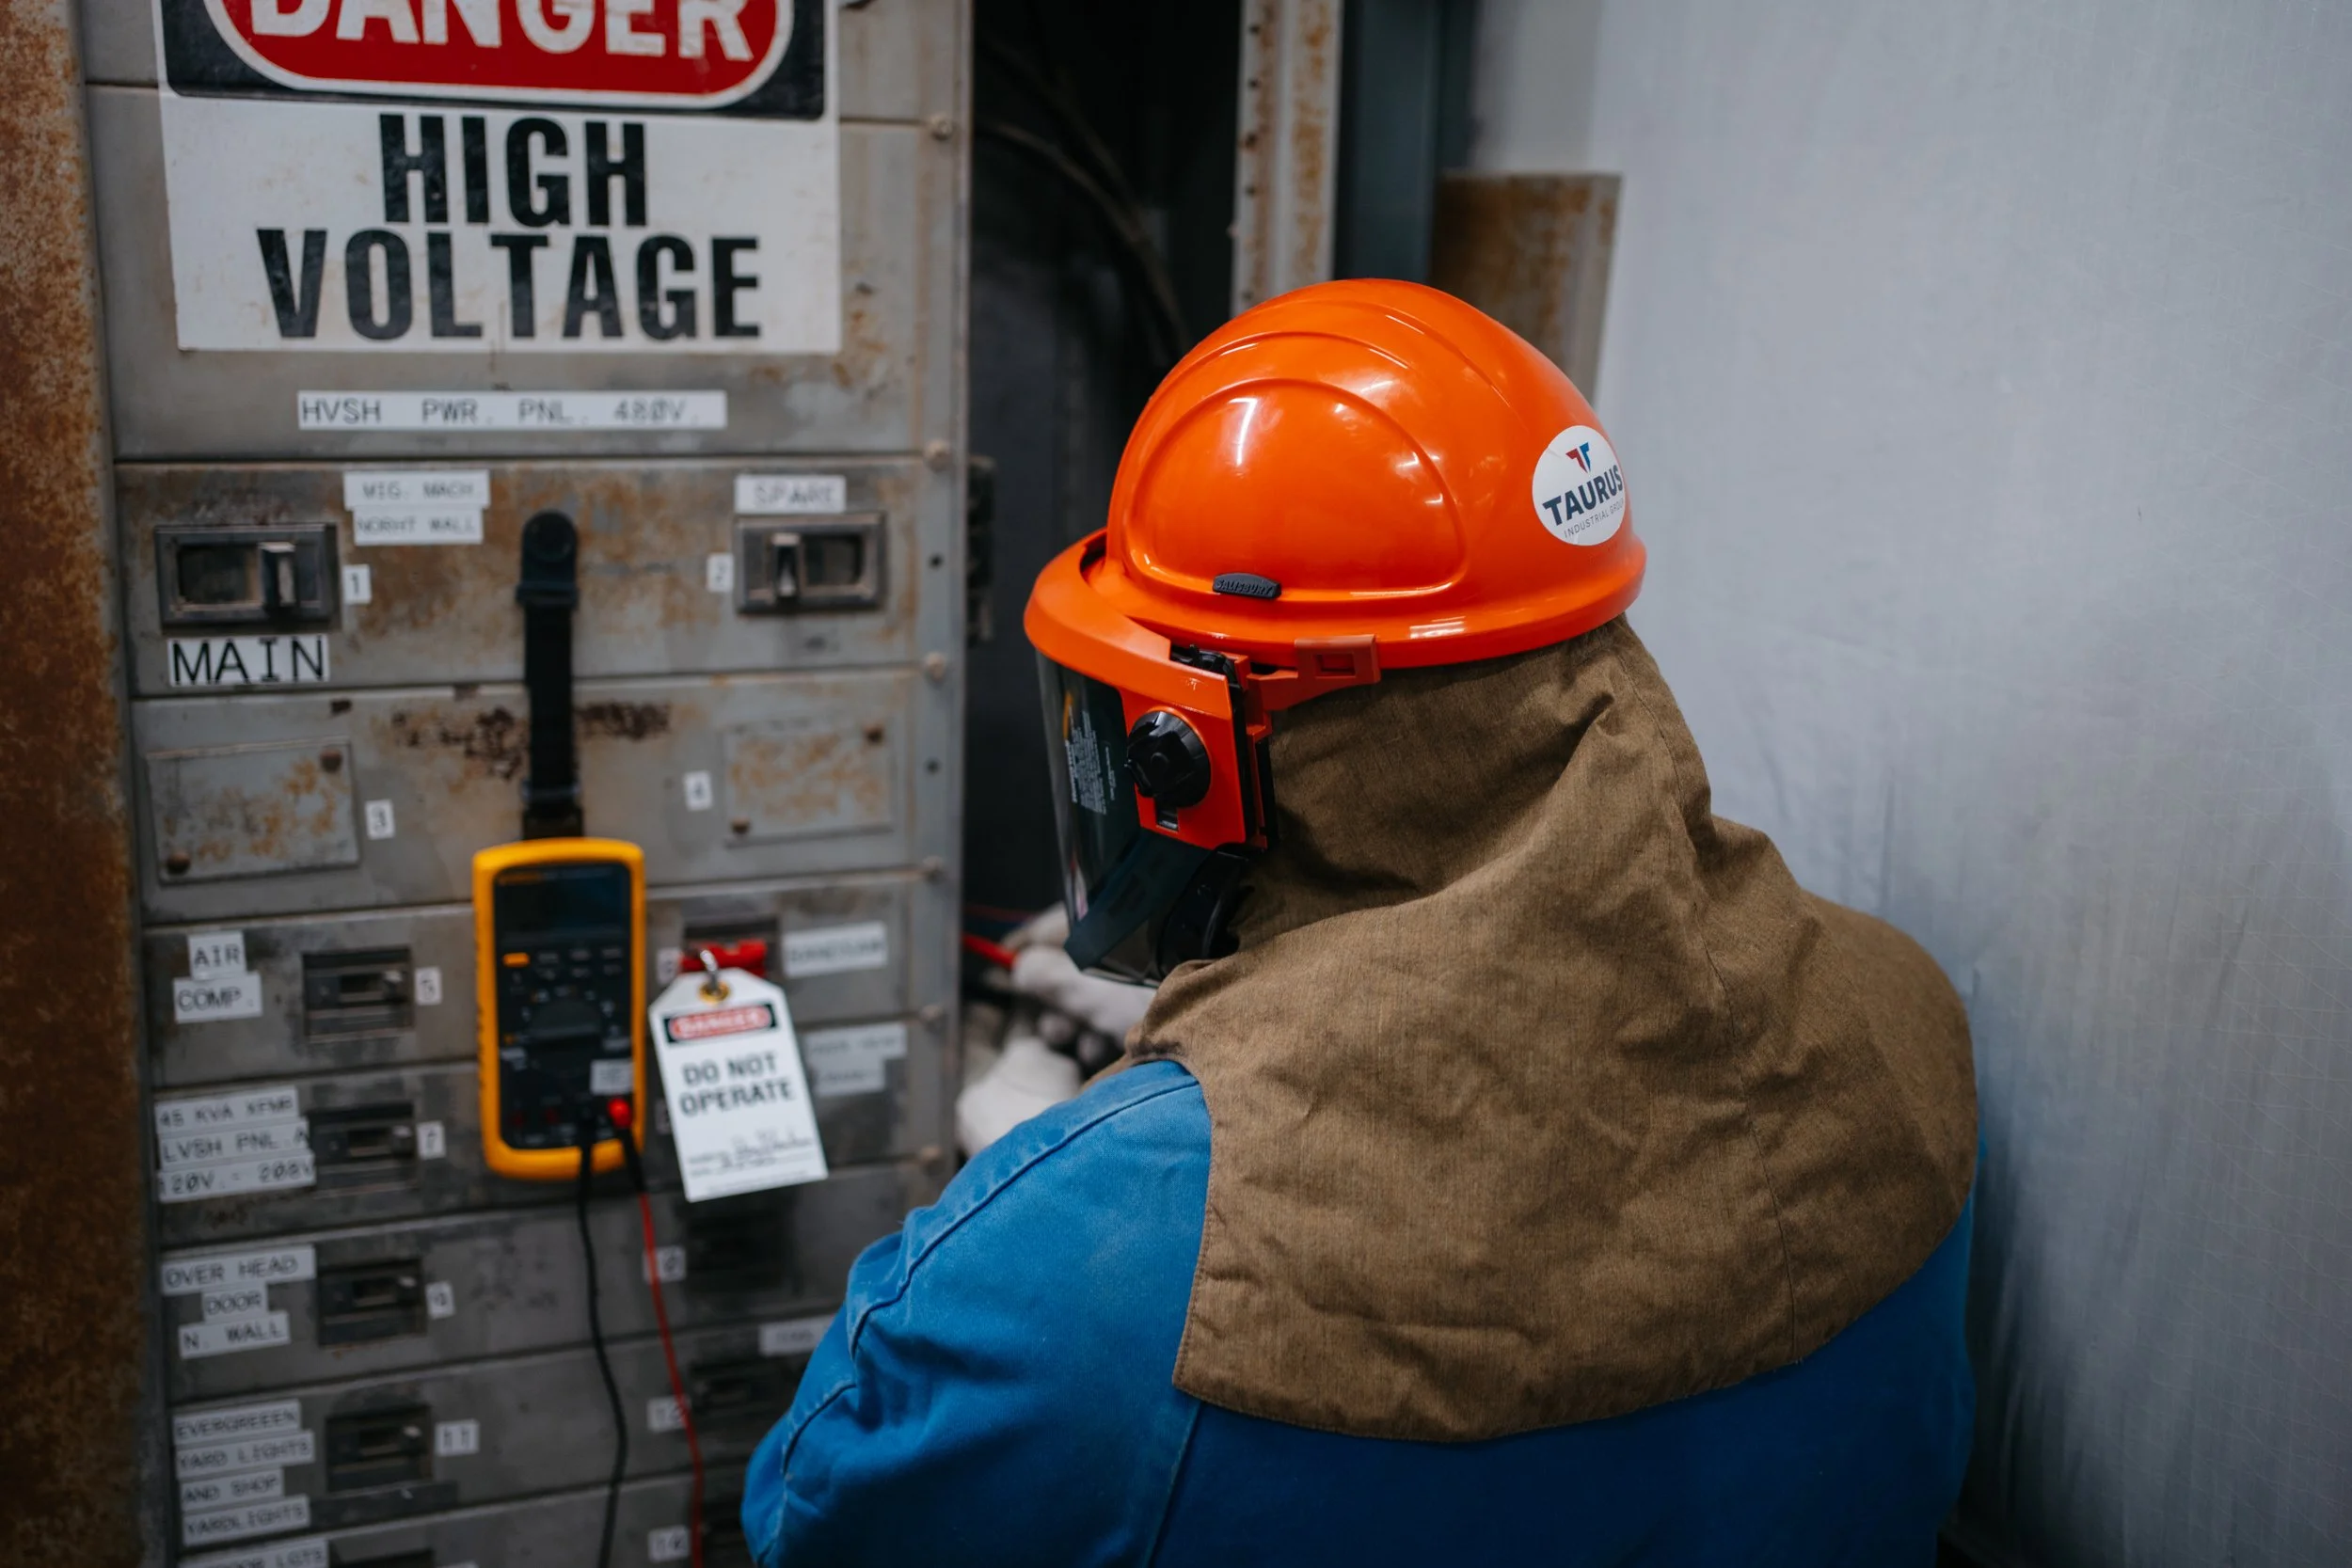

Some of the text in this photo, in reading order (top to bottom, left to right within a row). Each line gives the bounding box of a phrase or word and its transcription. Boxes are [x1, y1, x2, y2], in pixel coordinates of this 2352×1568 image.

[379, 113, 647, 229] HIGH
[256, 228, 763, 341] VOLTAGE
[301, 398, 382, 422] HVSH
[753, 484, 837, 506] SPARE
[1542, 464, 1624, 527] TAURUS
[1564, 509, 1610, 539] INDUSTRIAL
[1216, 578, 1273, 595] SALISBURY
[171, 635, 326, 687] MAIN
[194, 942, 241, 969] AIR
[677, 1011, 761, 1038] DANGER
[681, 1051, 777, 1086] DO NOT
[678, 1078, 796, 1117] OPERATE
[166, 1255, 299, 1288] OVER HEAD
[206, 1290, 262, 1316] DOOR
[225, 1319, 282, 1343] WALL
[183, 1484, 221, 1504] AND
